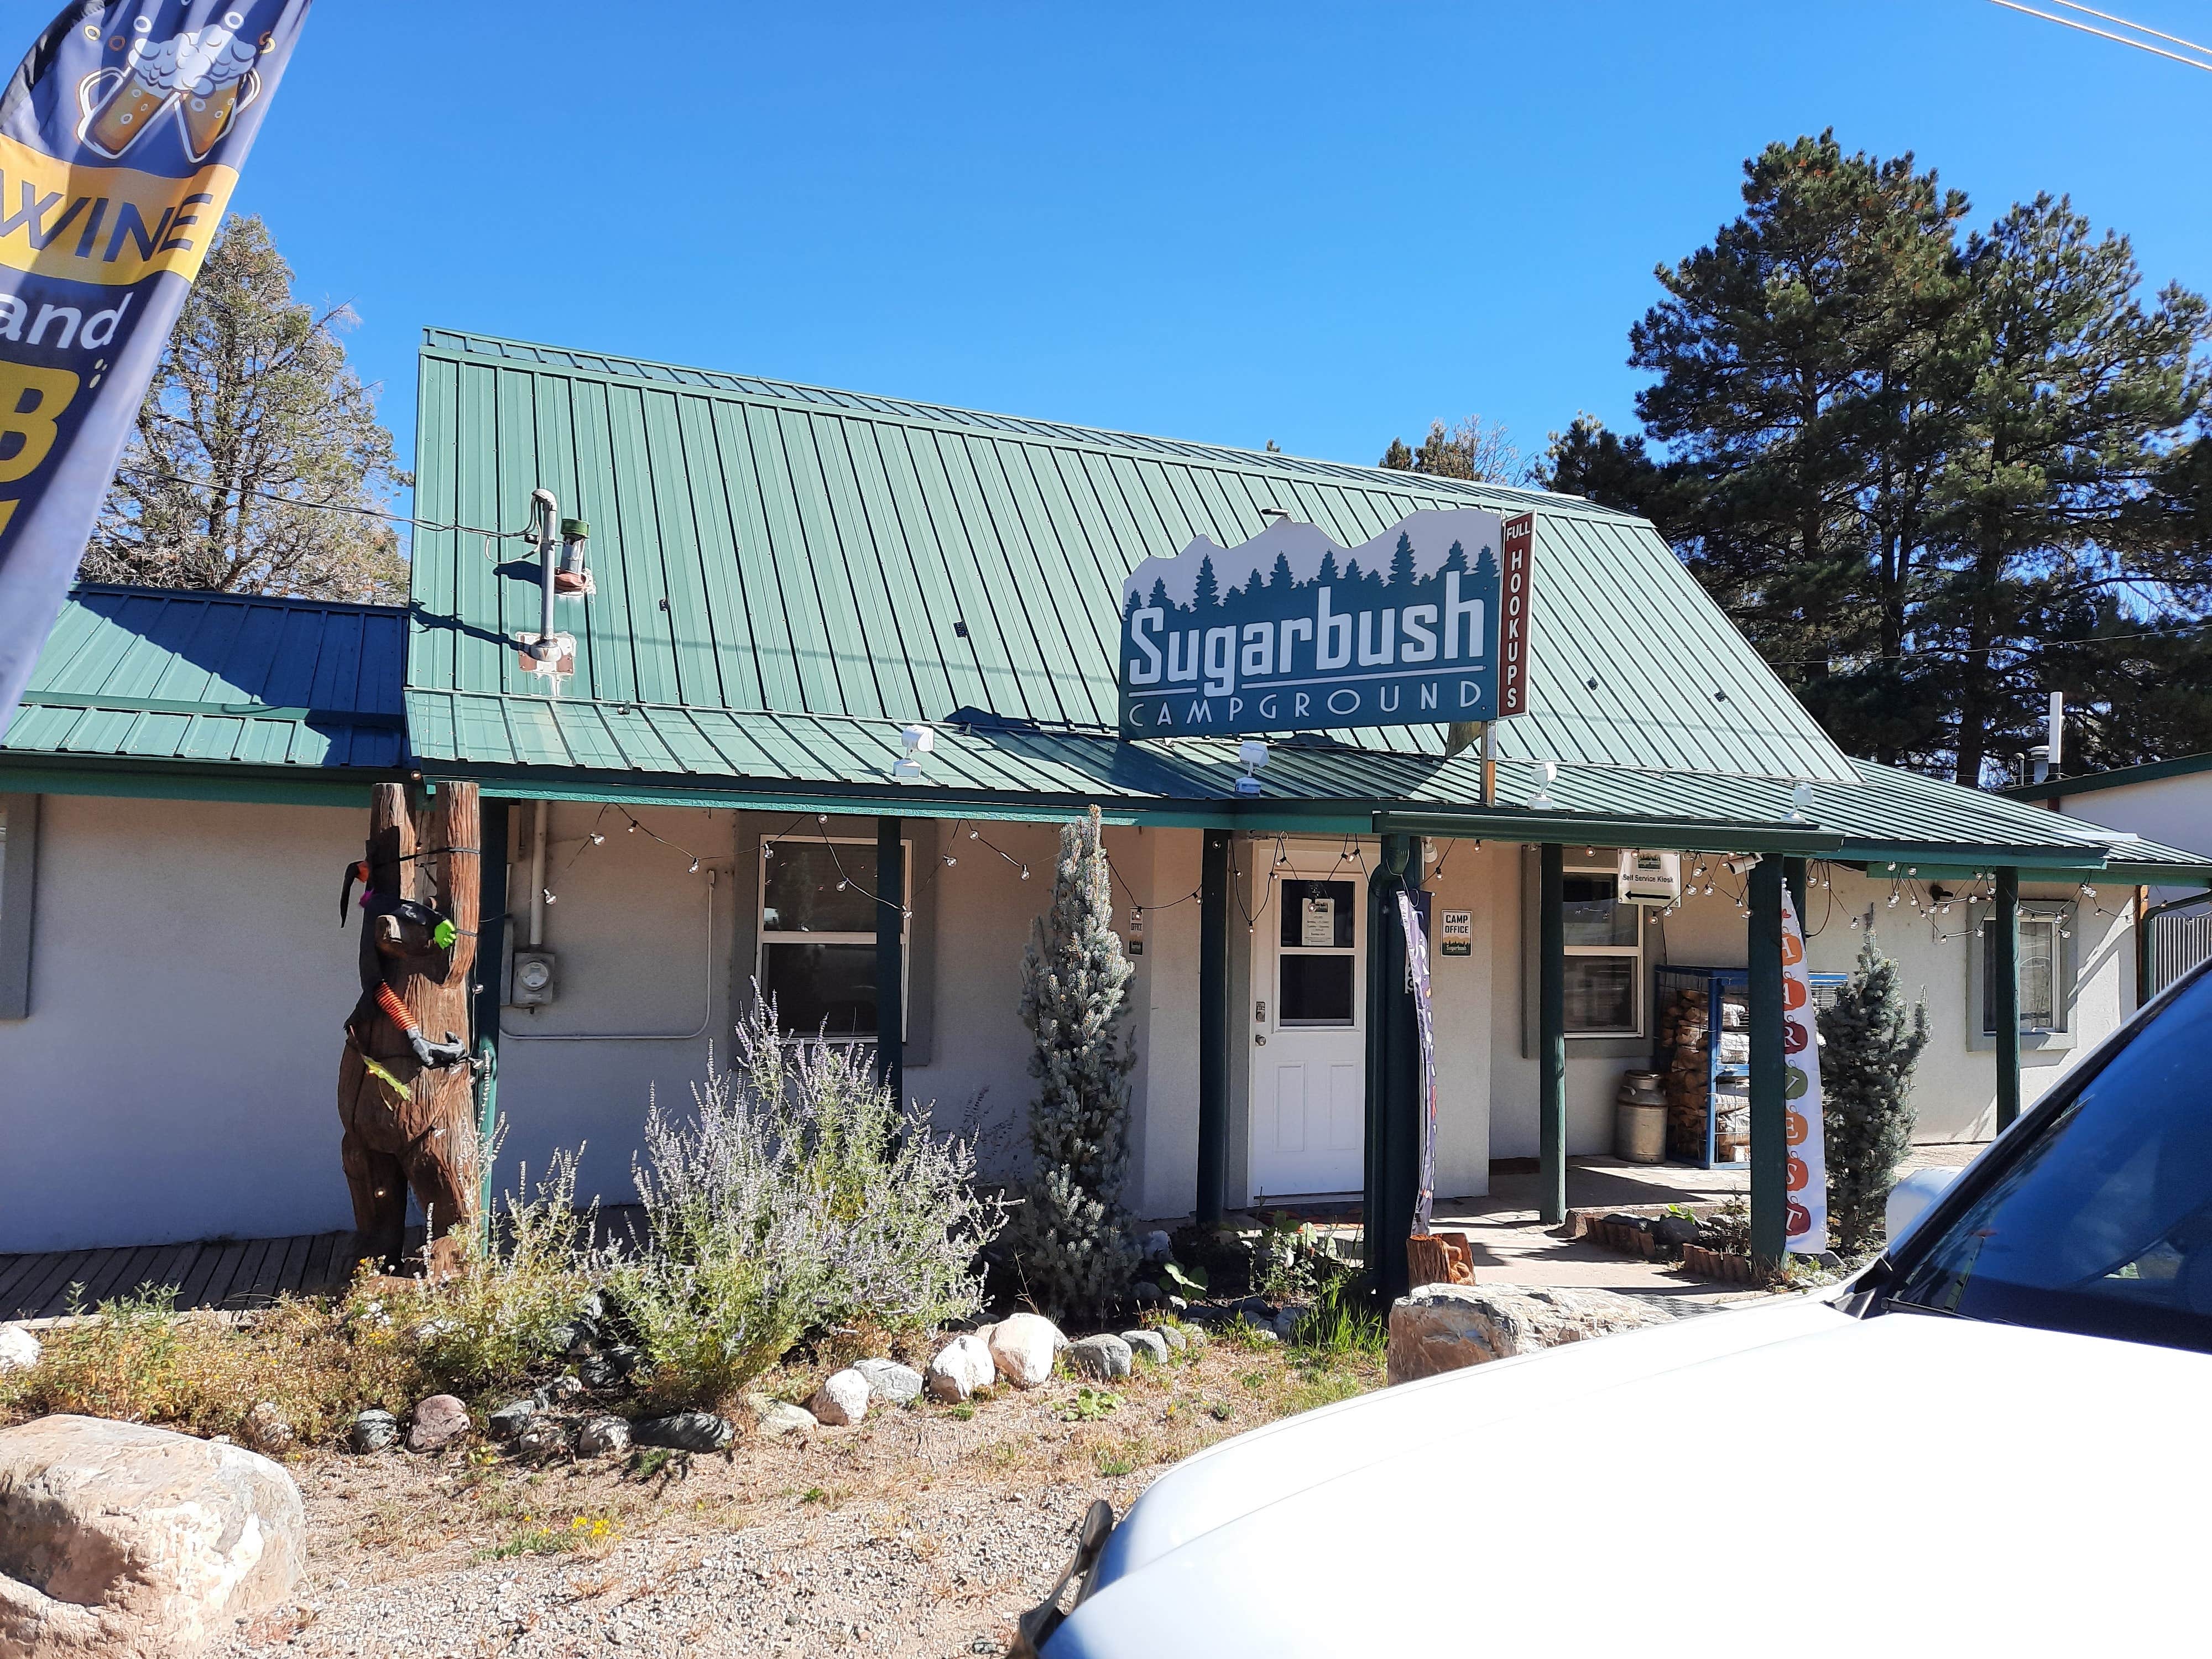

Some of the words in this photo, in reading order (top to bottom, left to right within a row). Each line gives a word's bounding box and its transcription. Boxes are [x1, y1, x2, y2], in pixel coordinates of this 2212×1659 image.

[0, 168, 213, 263] WINE
[0, 292, 134, 349] and
[1506, 521, 1531, 541] FULL
[1129, 570, 1485, 697] Sugarbush
[1506, 548, 1523, 708] HOOKUPS
[1129, 680, 1481, 727] CAMPGROUND
[1444, 925, 1469, 933] OFFICE
[1446, 915, 1468, 924] CAMP
